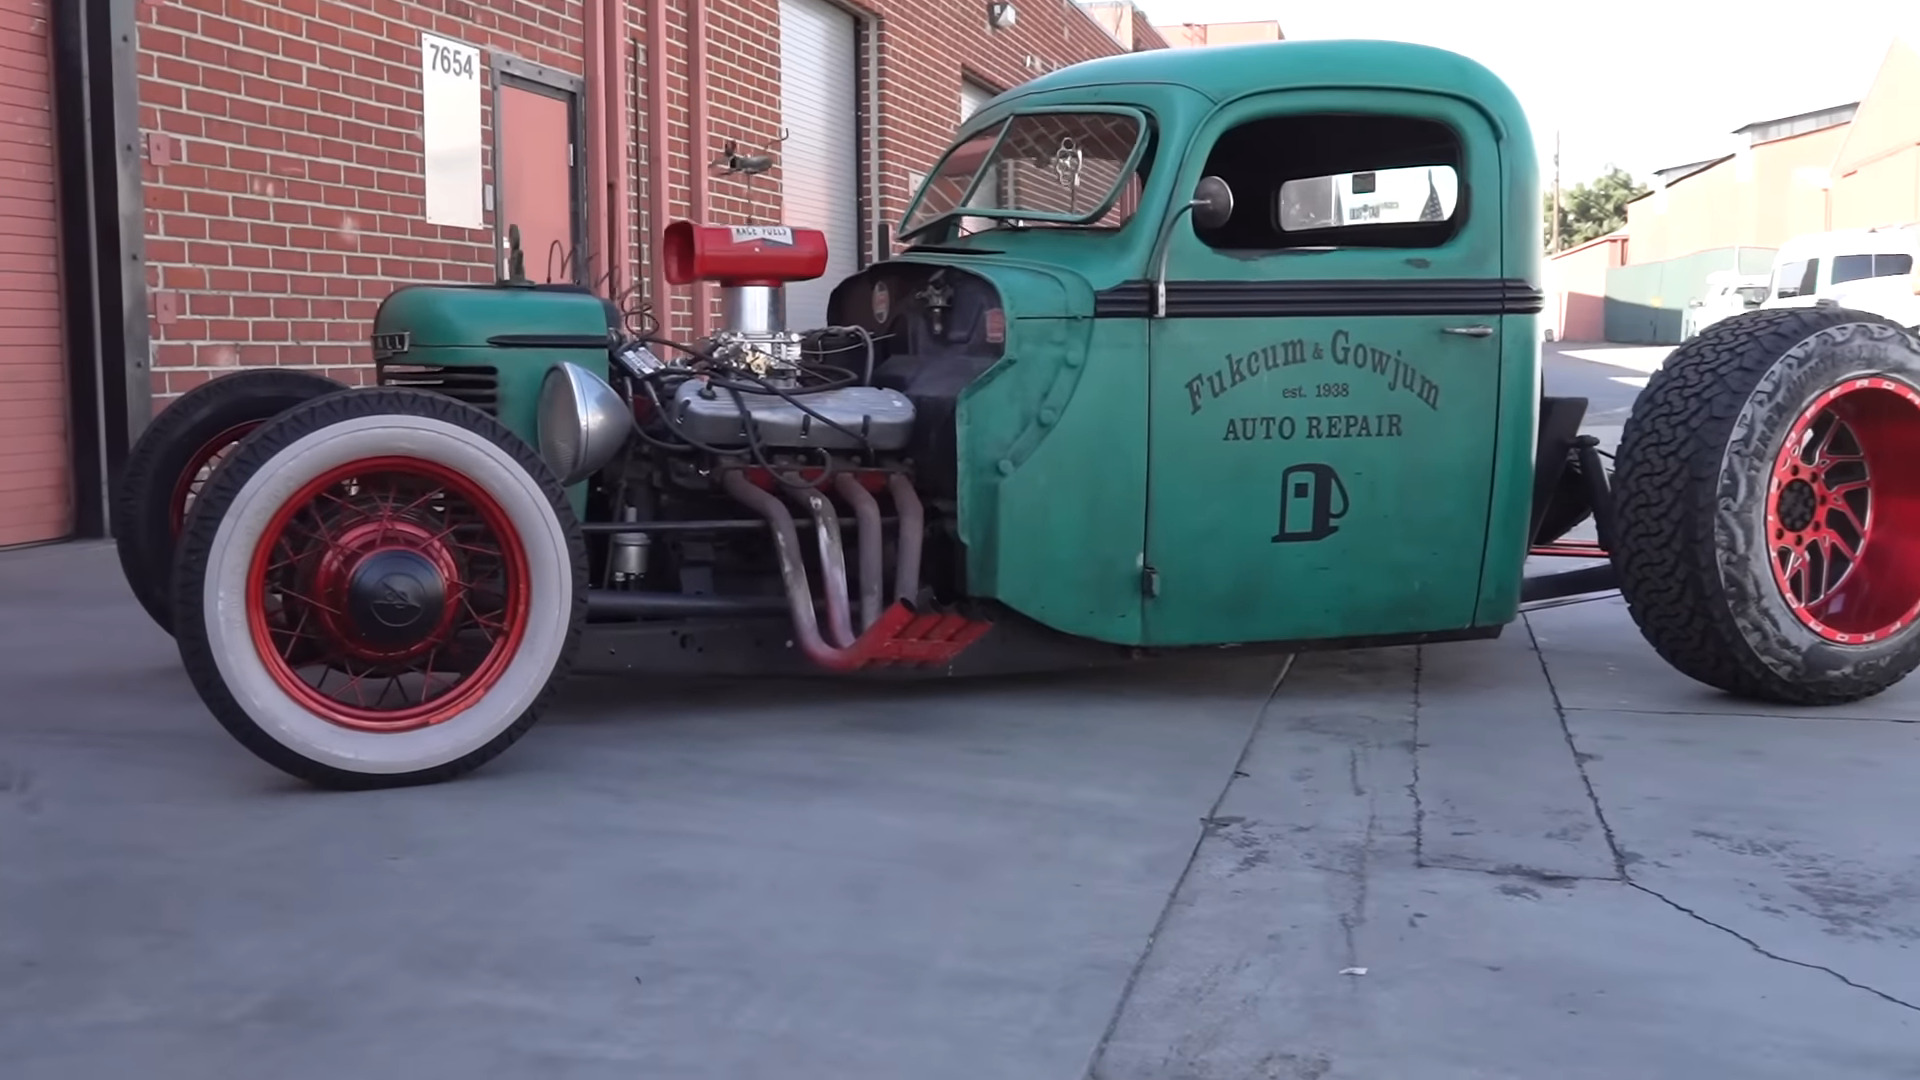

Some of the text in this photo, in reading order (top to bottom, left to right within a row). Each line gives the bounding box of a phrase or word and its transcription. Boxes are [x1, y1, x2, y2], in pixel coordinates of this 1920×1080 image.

[429, 43, 474, 80] 7654
[1184, 328, 1440, 416] Fukcum & Gowjum
[1282, 382, 1350, 399] est. 1938
[1222, 413, 1404, 442] AUTO REPAIR
